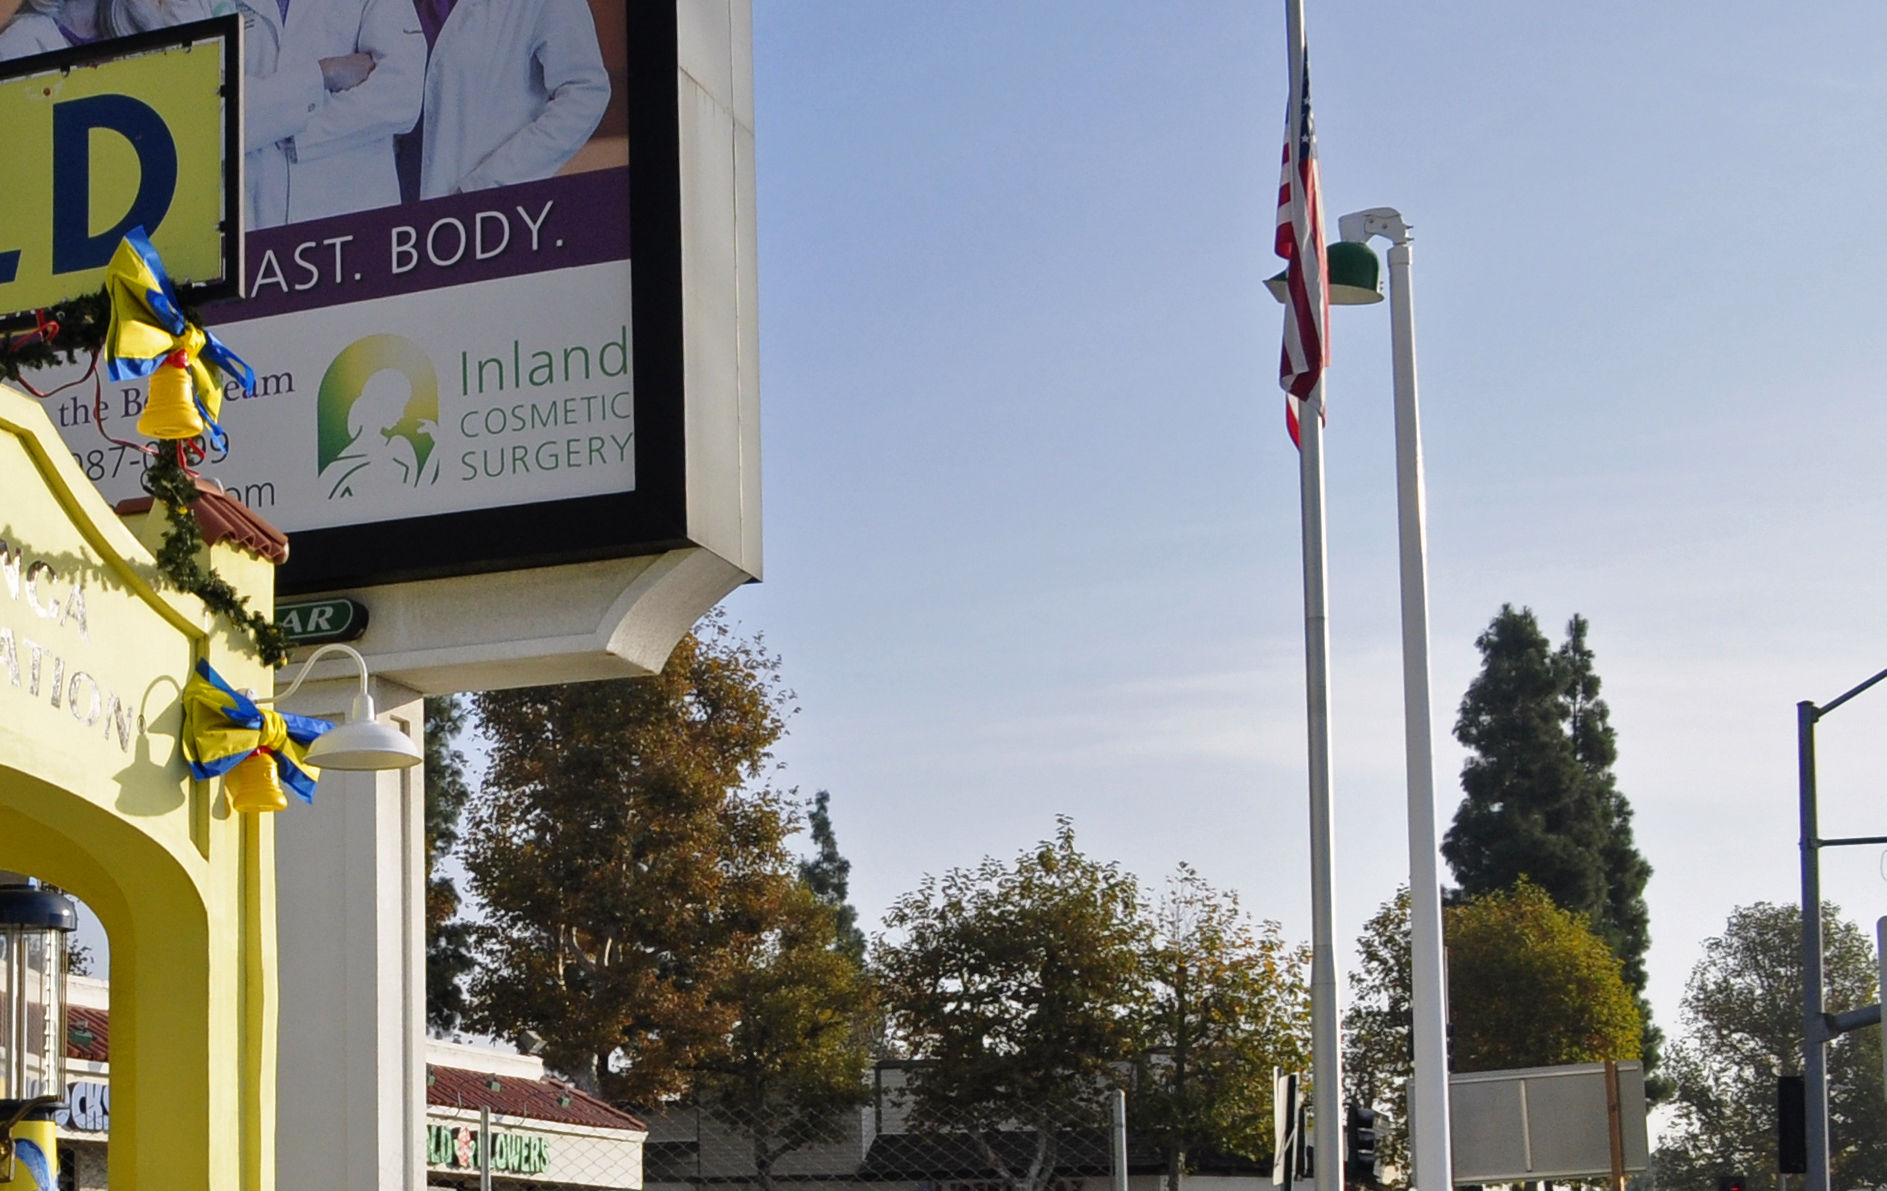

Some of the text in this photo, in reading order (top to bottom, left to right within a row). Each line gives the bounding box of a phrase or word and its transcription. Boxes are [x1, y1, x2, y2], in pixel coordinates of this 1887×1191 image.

[391, 200, 564, 274] BODY.
[462, 325, 628, 396] Inland
[58, 396, 110, 427] the
[222, 371, 295, 402] eam
[460, 391, 631, 438] COSMETIC
[461, 431, 633, 481] SURGERY
